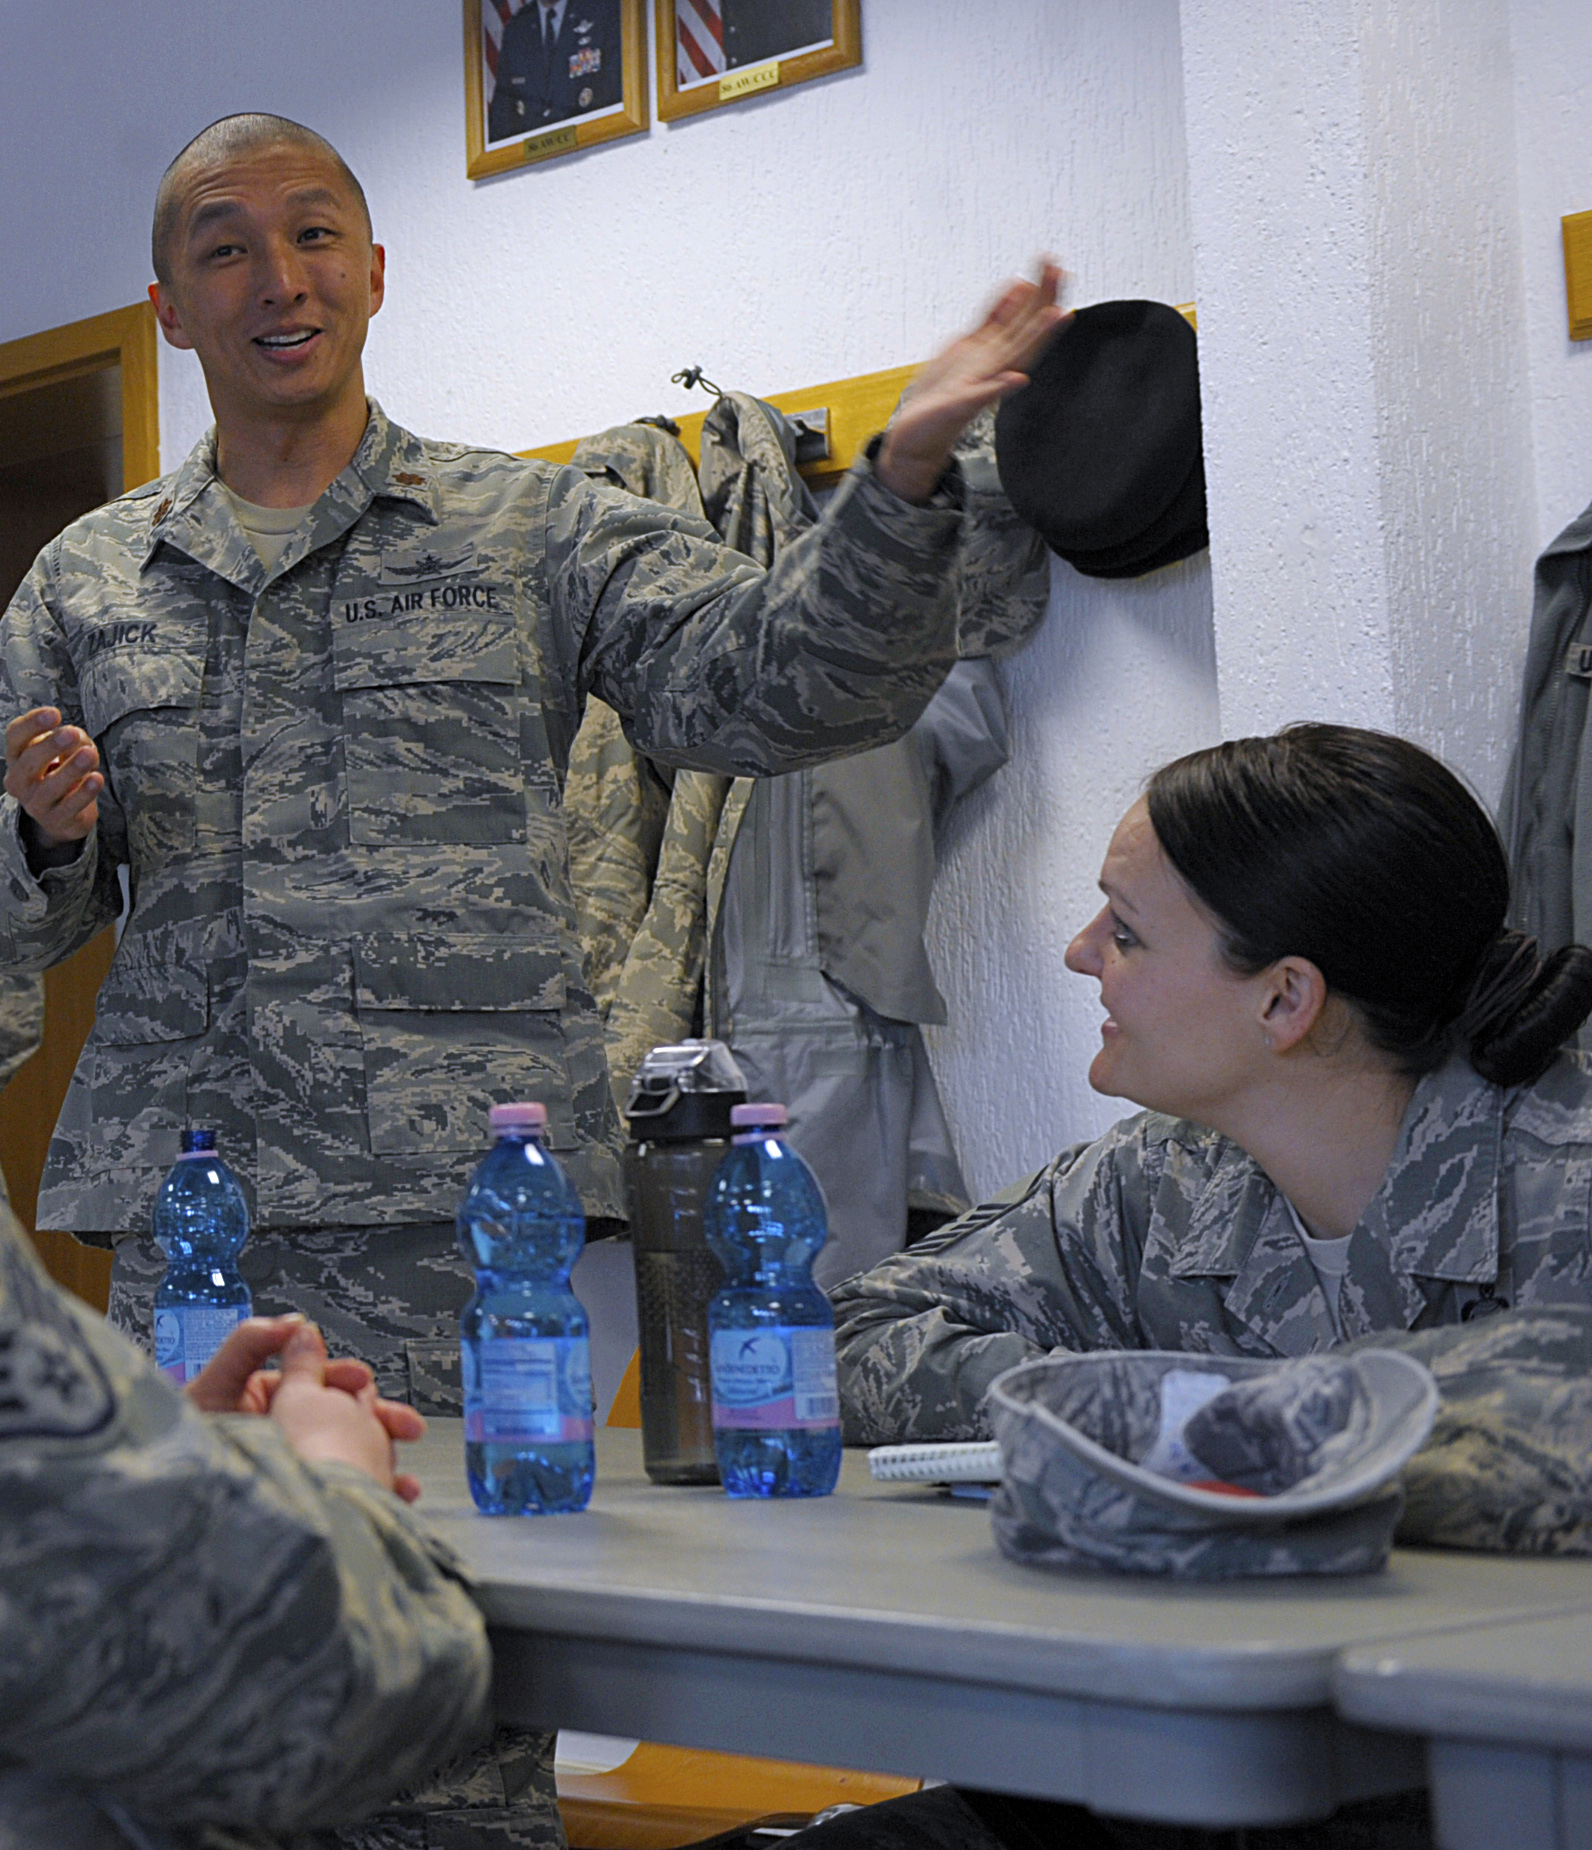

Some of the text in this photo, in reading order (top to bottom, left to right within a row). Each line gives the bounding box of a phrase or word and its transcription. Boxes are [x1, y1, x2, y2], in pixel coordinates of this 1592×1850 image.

[345, 584, 498, 623] U.S. AIR FORCE
